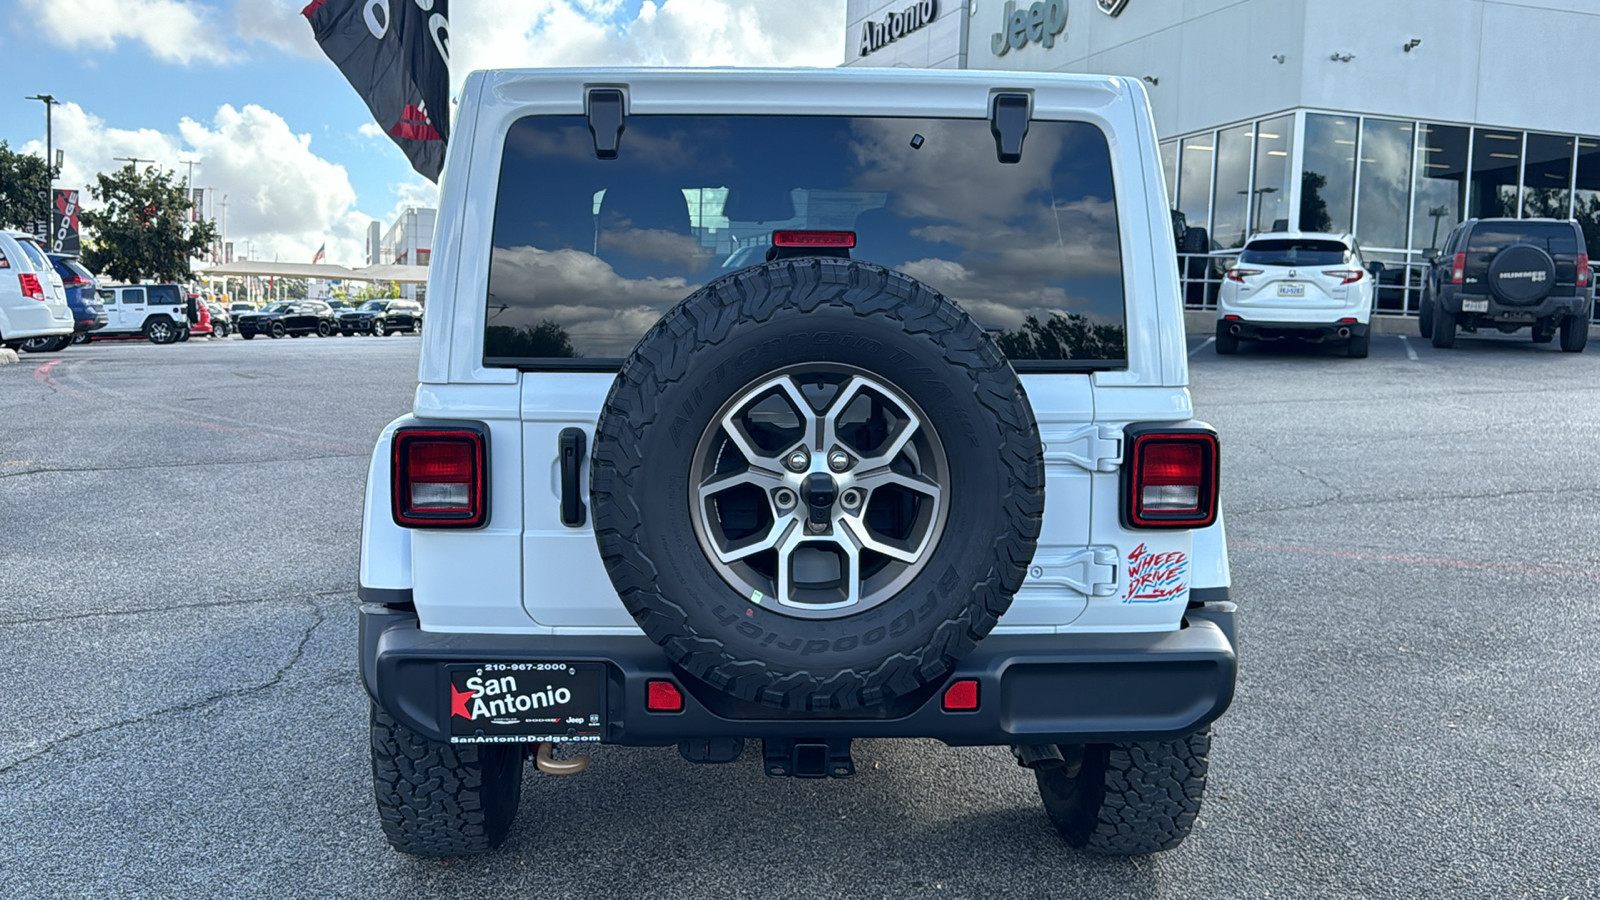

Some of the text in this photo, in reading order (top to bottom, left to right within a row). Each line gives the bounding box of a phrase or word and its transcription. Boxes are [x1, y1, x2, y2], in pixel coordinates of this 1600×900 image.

[858, 0, 938, 57] Antonio
[991, 0, 1065, 56] Jeep
[54, 191, 78, 253] DODGE
[1128, 542, 1147, 563] 4
[1128, 551, 1187, 577] WHEEL
[1128, 567, 1182, 599] DRIVE
[711, 565, 960, 656] BFGoodrich
[466, 675, 517, 698] San
[471, 685, 571, 720] Antonio
[450, 735, 601, 744] SanAntonioDodge.com
